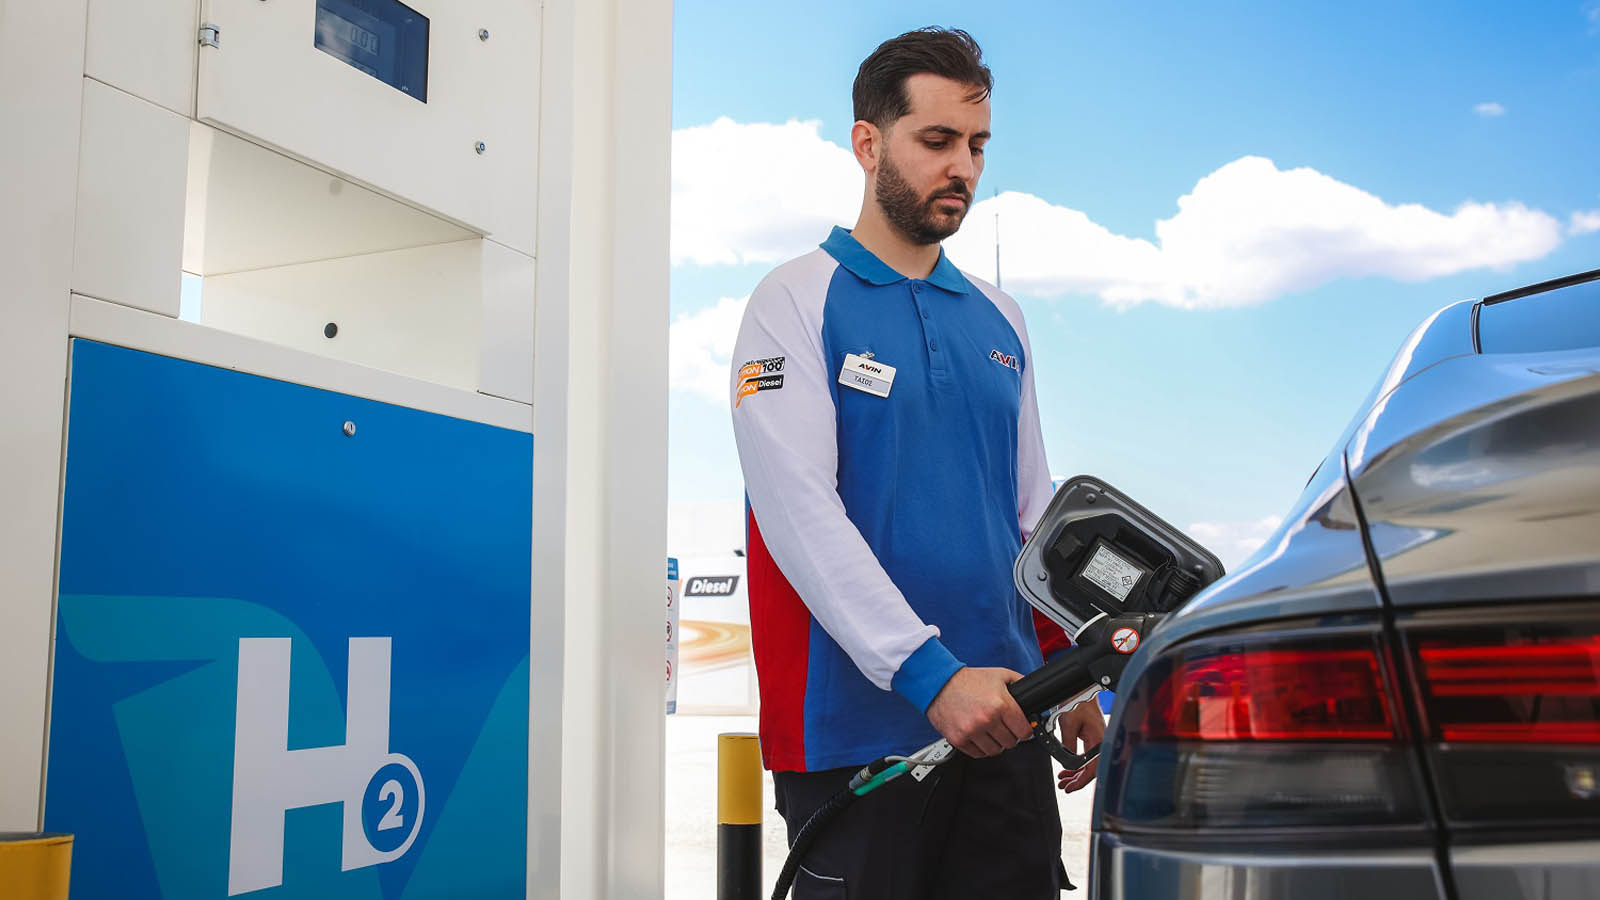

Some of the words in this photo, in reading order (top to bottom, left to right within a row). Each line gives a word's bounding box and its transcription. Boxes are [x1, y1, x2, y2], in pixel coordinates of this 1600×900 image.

[762, 361, 783, 373] 100
[989, 349, 1020, 373] AVI
[858, 363, 882, 374] AVIN
[759, 378, 782, 388] Diesel
[690, 577, 733, 595] Diesel
